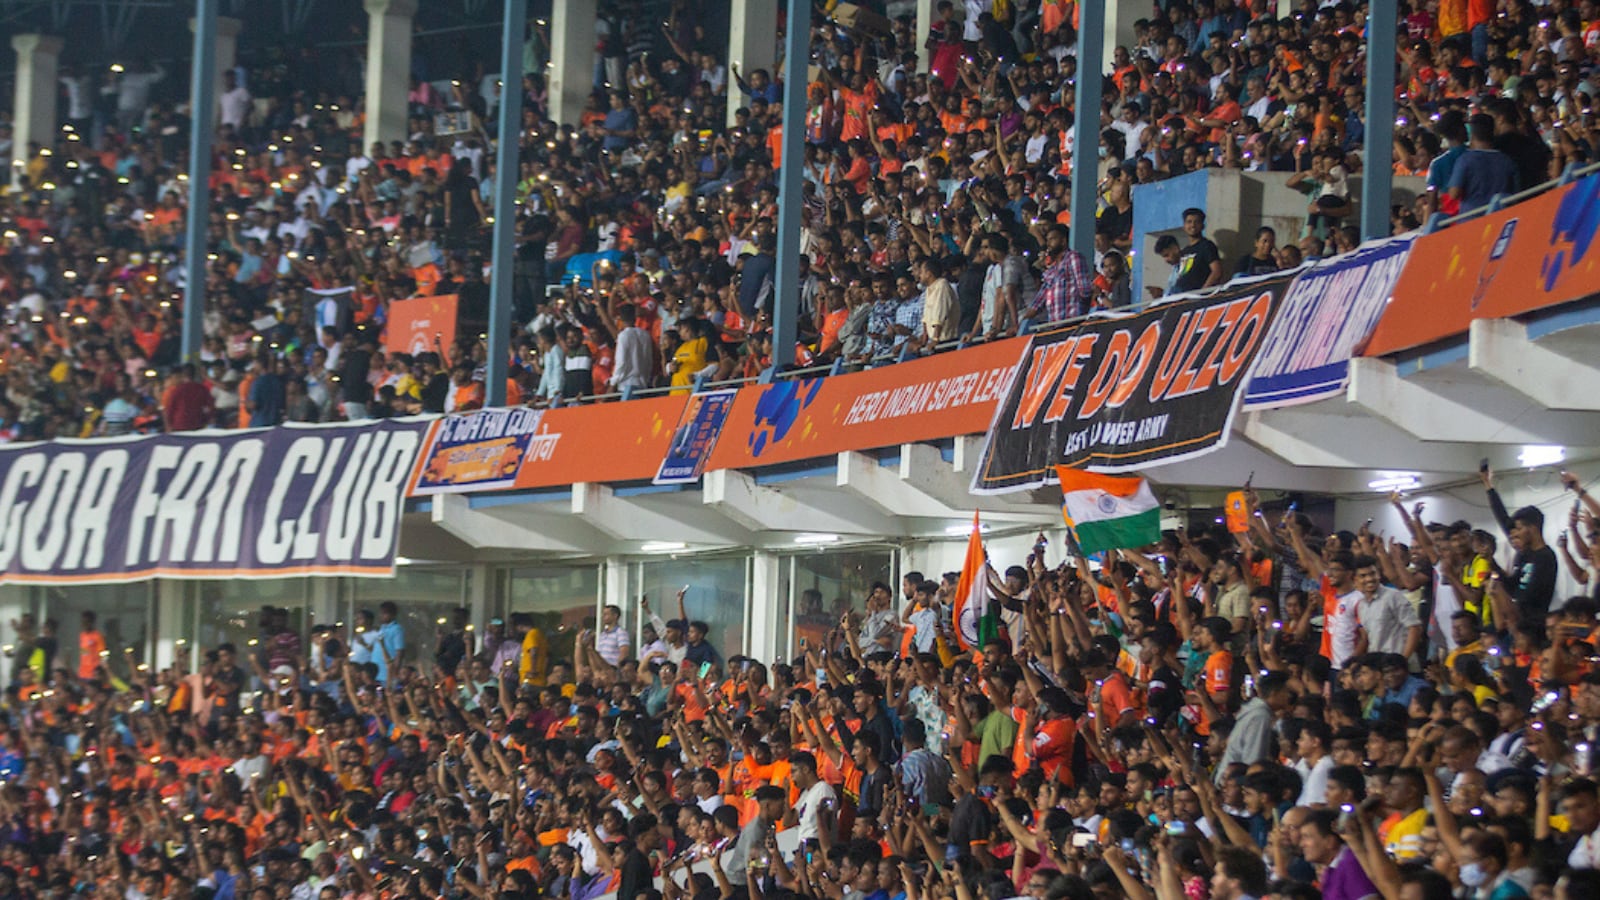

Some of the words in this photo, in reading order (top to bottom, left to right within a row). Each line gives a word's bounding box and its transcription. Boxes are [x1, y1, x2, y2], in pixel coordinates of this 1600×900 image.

[1011, 332, 1100, 431] WE
[1077, 318, 1162, 420] DO
[1149, 290, 1274, 403] UZZO
[453, 411, 484, 441] GOA
[479, 409, 510, 439] FAN
[505, 406, 542, 436] CLUB
[843, 394, 887, 427] HERO
[880, 382, 934, 420] INDIAN
[927, 372, 977, 413] SUPER
[1135, 412, 1170, 442] ARMY
[0, 448, 130, 571] GOA
[125, 438, 265, 567] FAN
[256, 430, 420, 565] CLUB
